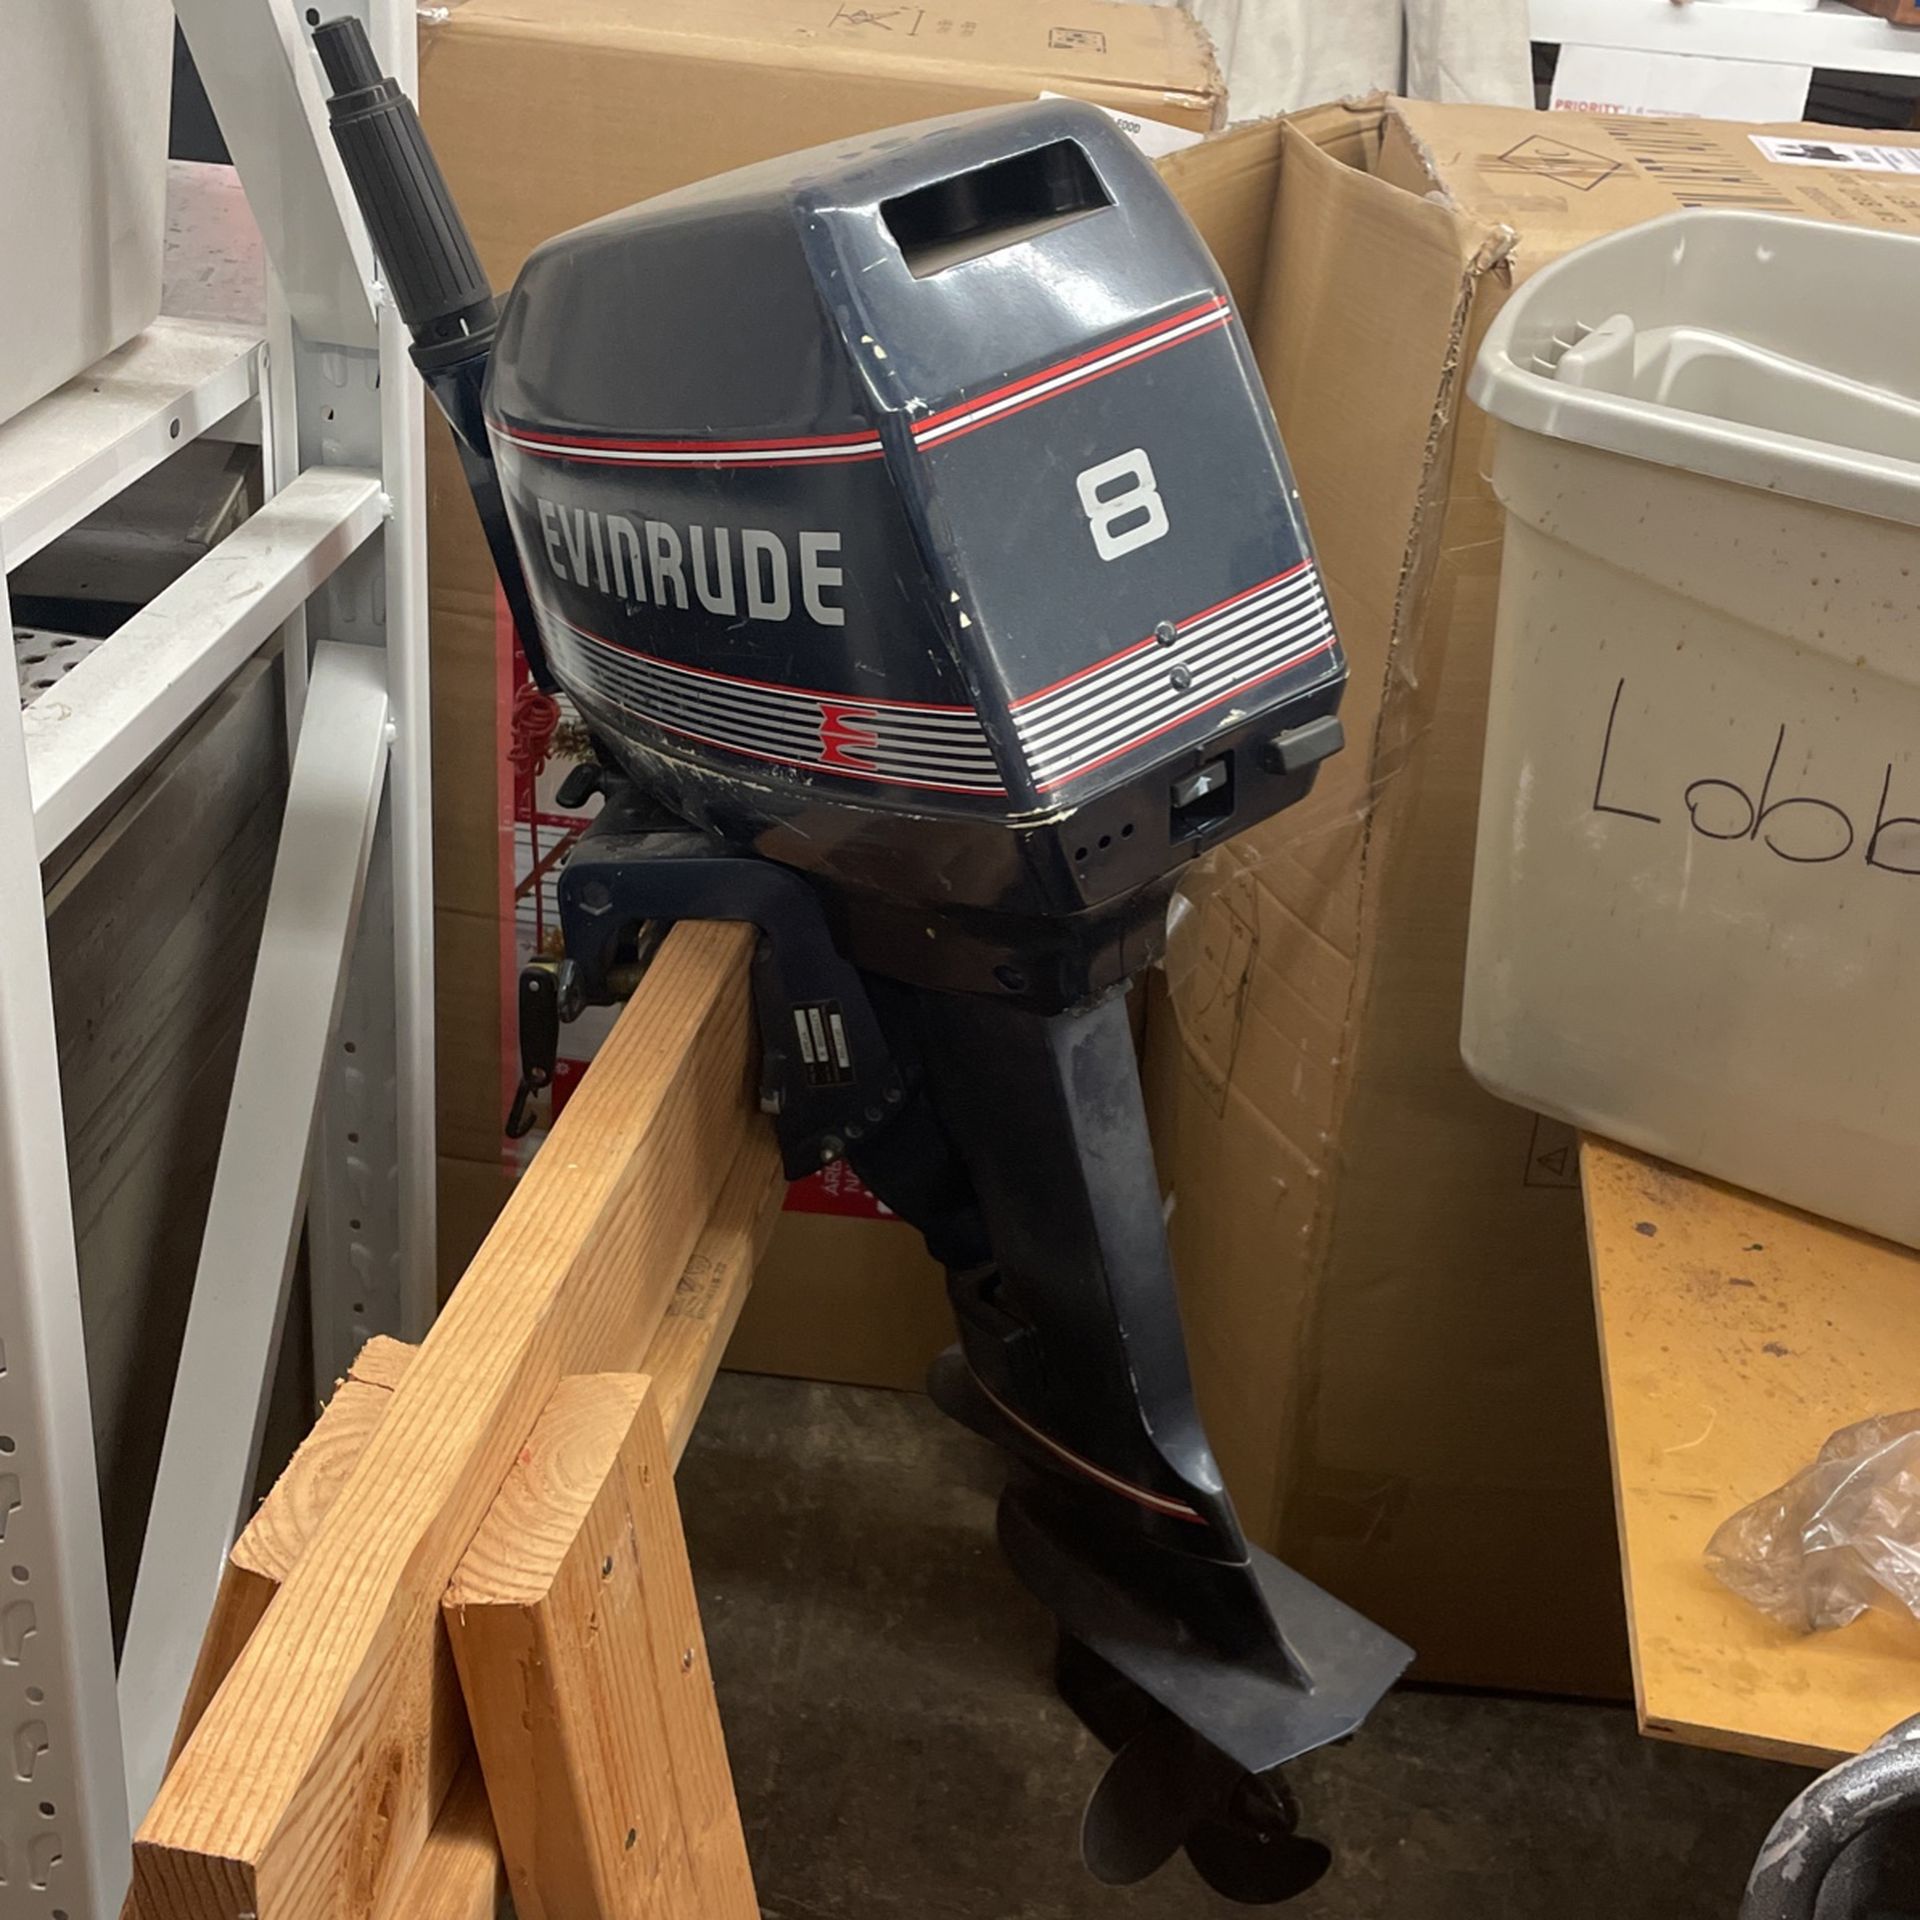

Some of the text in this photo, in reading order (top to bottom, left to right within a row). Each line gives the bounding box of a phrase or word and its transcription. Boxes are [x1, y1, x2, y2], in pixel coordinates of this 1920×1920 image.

[1555, 98, 1618, 114] PRIORITY
[538, 498, 845, 626] EVINRUDE
[1076, 448, 1169, 562] 8
